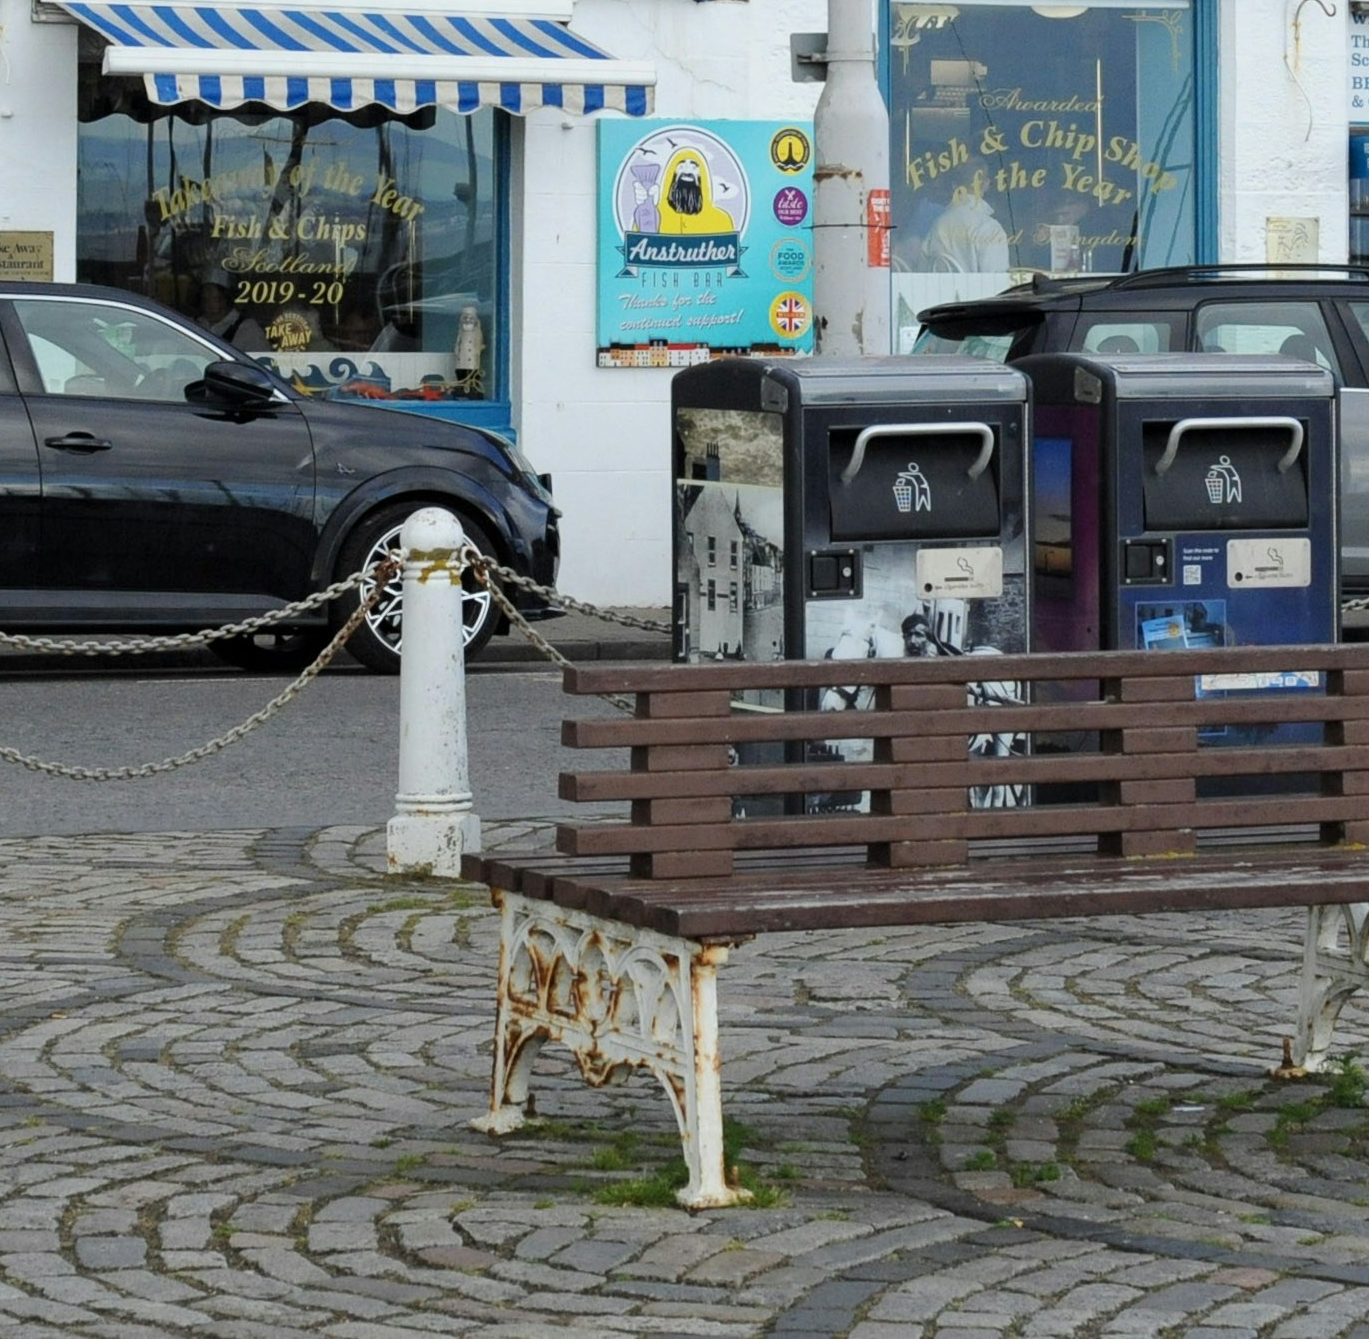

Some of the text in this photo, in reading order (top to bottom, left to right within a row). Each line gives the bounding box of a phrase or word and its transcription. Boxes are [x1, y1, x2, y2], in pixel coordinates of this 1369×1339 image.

[980, 86, 1105, 113] Awarded
[1351, 95, 1364, 108] &
[908, 121, 1178, 196] Fish & Chip Shop
[152, 158, 425, 222] Takeaway of the Year
[951, 161, 1132, 208] of the Year
[211, 215, 367, 243] Fish & Chips
[13, 243, 43, 255] Away
[629, 238, 735, 261] Anstruther
[778, 252, 804, 260] FOOD
[221, 247, 356, 274] Scotland
[641, 271, 724, 288] FISH BAR
[618, 290, 717, 311] Thanks for the
[265, 323, 292, 339] TAKE
[620, 309, 744, 331] continued support!
[281, 330, 312, 348] AWAY
